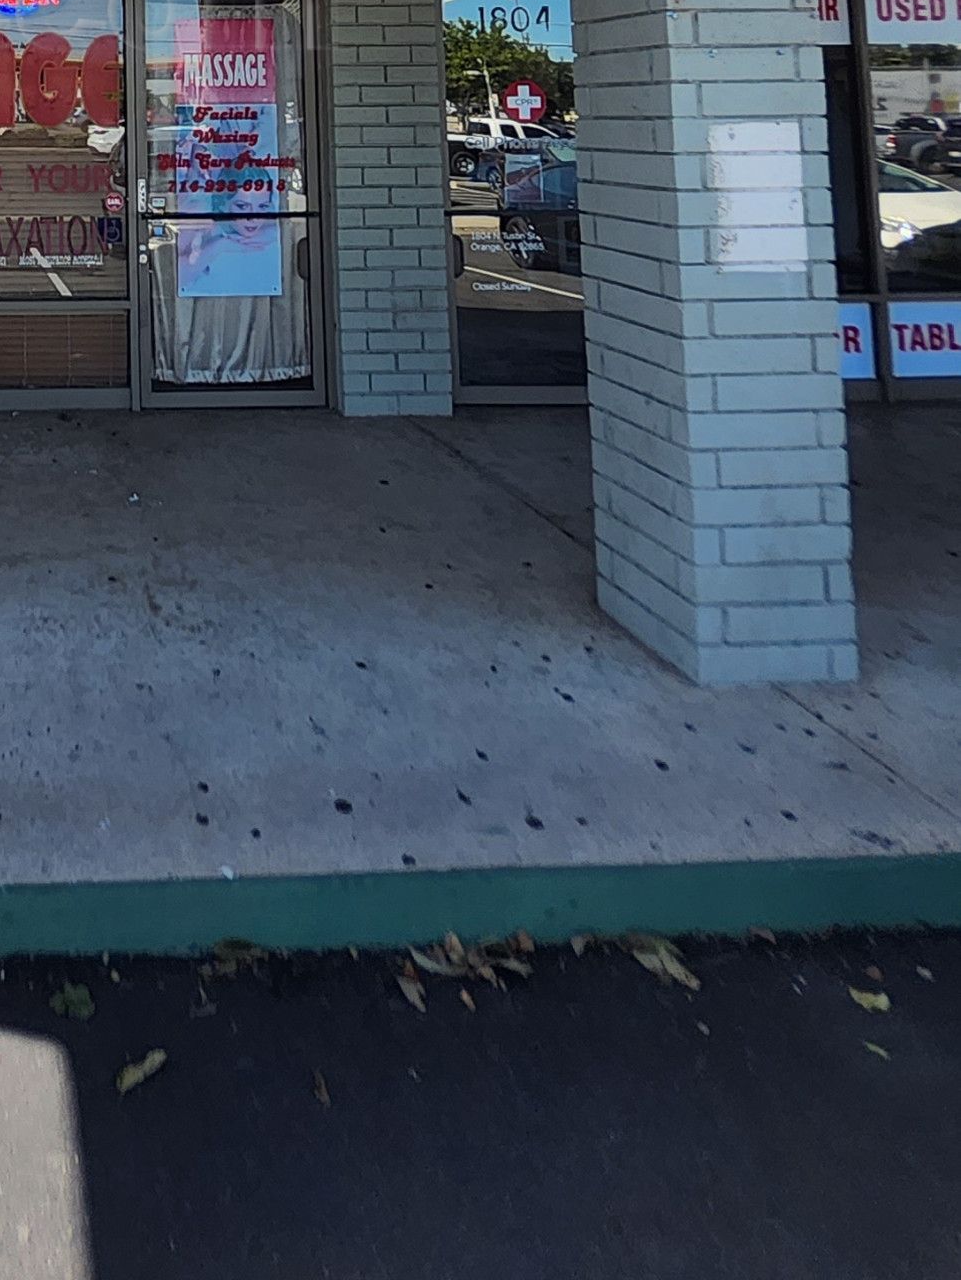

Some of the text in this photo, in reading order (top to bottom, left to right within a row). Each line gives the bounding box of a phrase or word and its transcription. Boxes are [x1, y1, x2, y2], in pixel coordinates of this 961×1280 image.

[478, 5, 550, 34] 1804
[182, 52, 267, 88] MASSAGE
[192, 106, 259, 122] Facials
[192, 128, 260, 146] Waxing
[28, 163, 116, 194] YOUR
